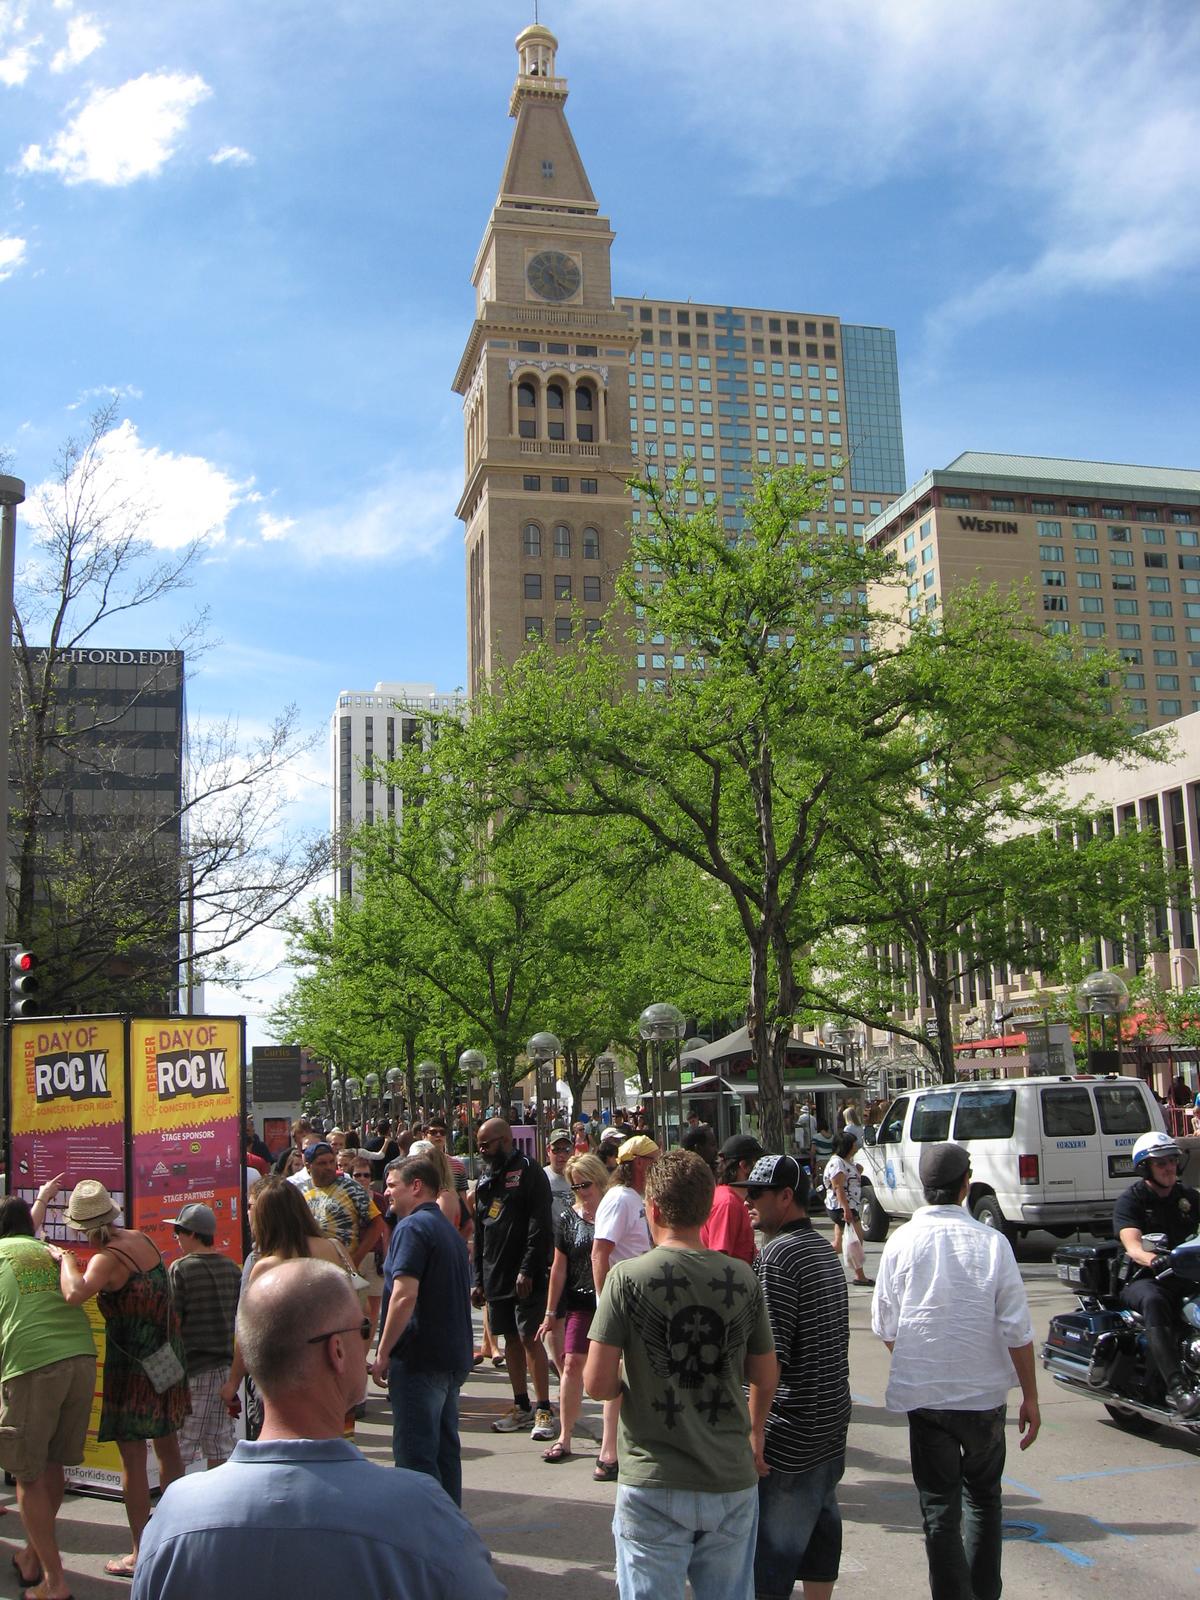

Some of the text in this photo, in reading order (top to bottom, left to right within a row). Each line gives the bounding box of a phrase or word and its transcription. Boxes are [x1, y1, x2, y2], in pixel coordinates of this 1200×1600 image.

[957, 516, 1018, 534] WESTIN
[38, 1026, 98, 1054] DAY OF
[159, 1026, 218, 1051] DAY OF
[25, 1040, 36, 1095] DENVER
[36, 1053, 107, 1096] ROCK
[145, 1036, 158, 1093] DENVER
[157, 1051, 226, 1094] ROCK
[37, 1105, 75, 1116] CONCERTS
[159, 1102, 197, 1114] CONCERTS
[161, 1130, 215, 1142] STAGE SPONSORS
[1057, 1140, 1086, 1148] DENVER
[163, 1190, 215, 1204] STAGE PARTNERS
